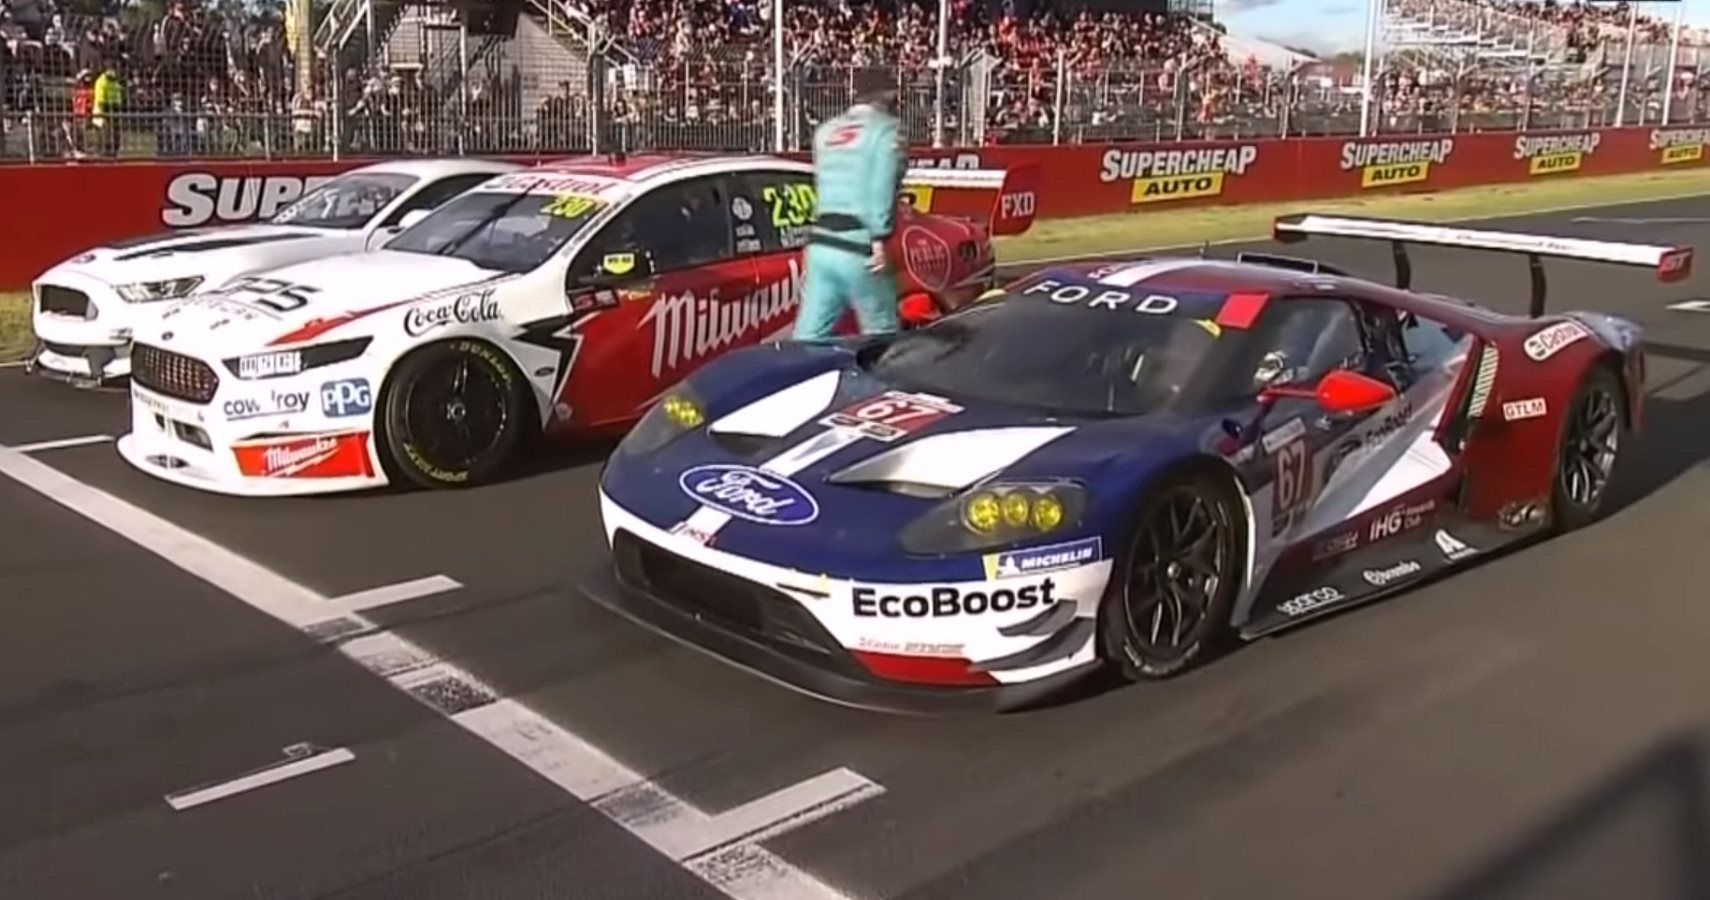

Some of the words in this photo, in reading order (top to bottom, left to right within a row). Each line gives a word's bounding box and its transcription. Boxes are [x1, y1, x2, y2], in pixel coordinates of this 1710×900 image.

[1340, 139, 1452, 169] SUPERCHEAP
[1514, 133, 1600, 159] SUPERCHEAP
[1668, 147, 1698, 158] AUTO
[1100, 146, 1257, 182] SUPERCHEAP
[1371, 165, 1420, 182] AUTO
[1536, 155, 1575, 169] AUTO
[1143, 177, 1213, 196] AUTO
[540, 196, 596, 218] 230
[763, 184, 816, 227] 230
[1001, 191, 1034, 219] FXD
[1023, 280, 1178, 314] FORD
[323, 381, 371, 415] PPG
[857, 400, 940, 424] 67
[1505, 400, 1545, 417] GTLM
[1278, 440, 1305, 511] 67
[696, 470, 795, 516] Ford
[1369, 509, 1402, 541] IHG
[1021, 548, 1093, 569] MICHELIN
[852, 578, 1055, 618] EcoBoost
